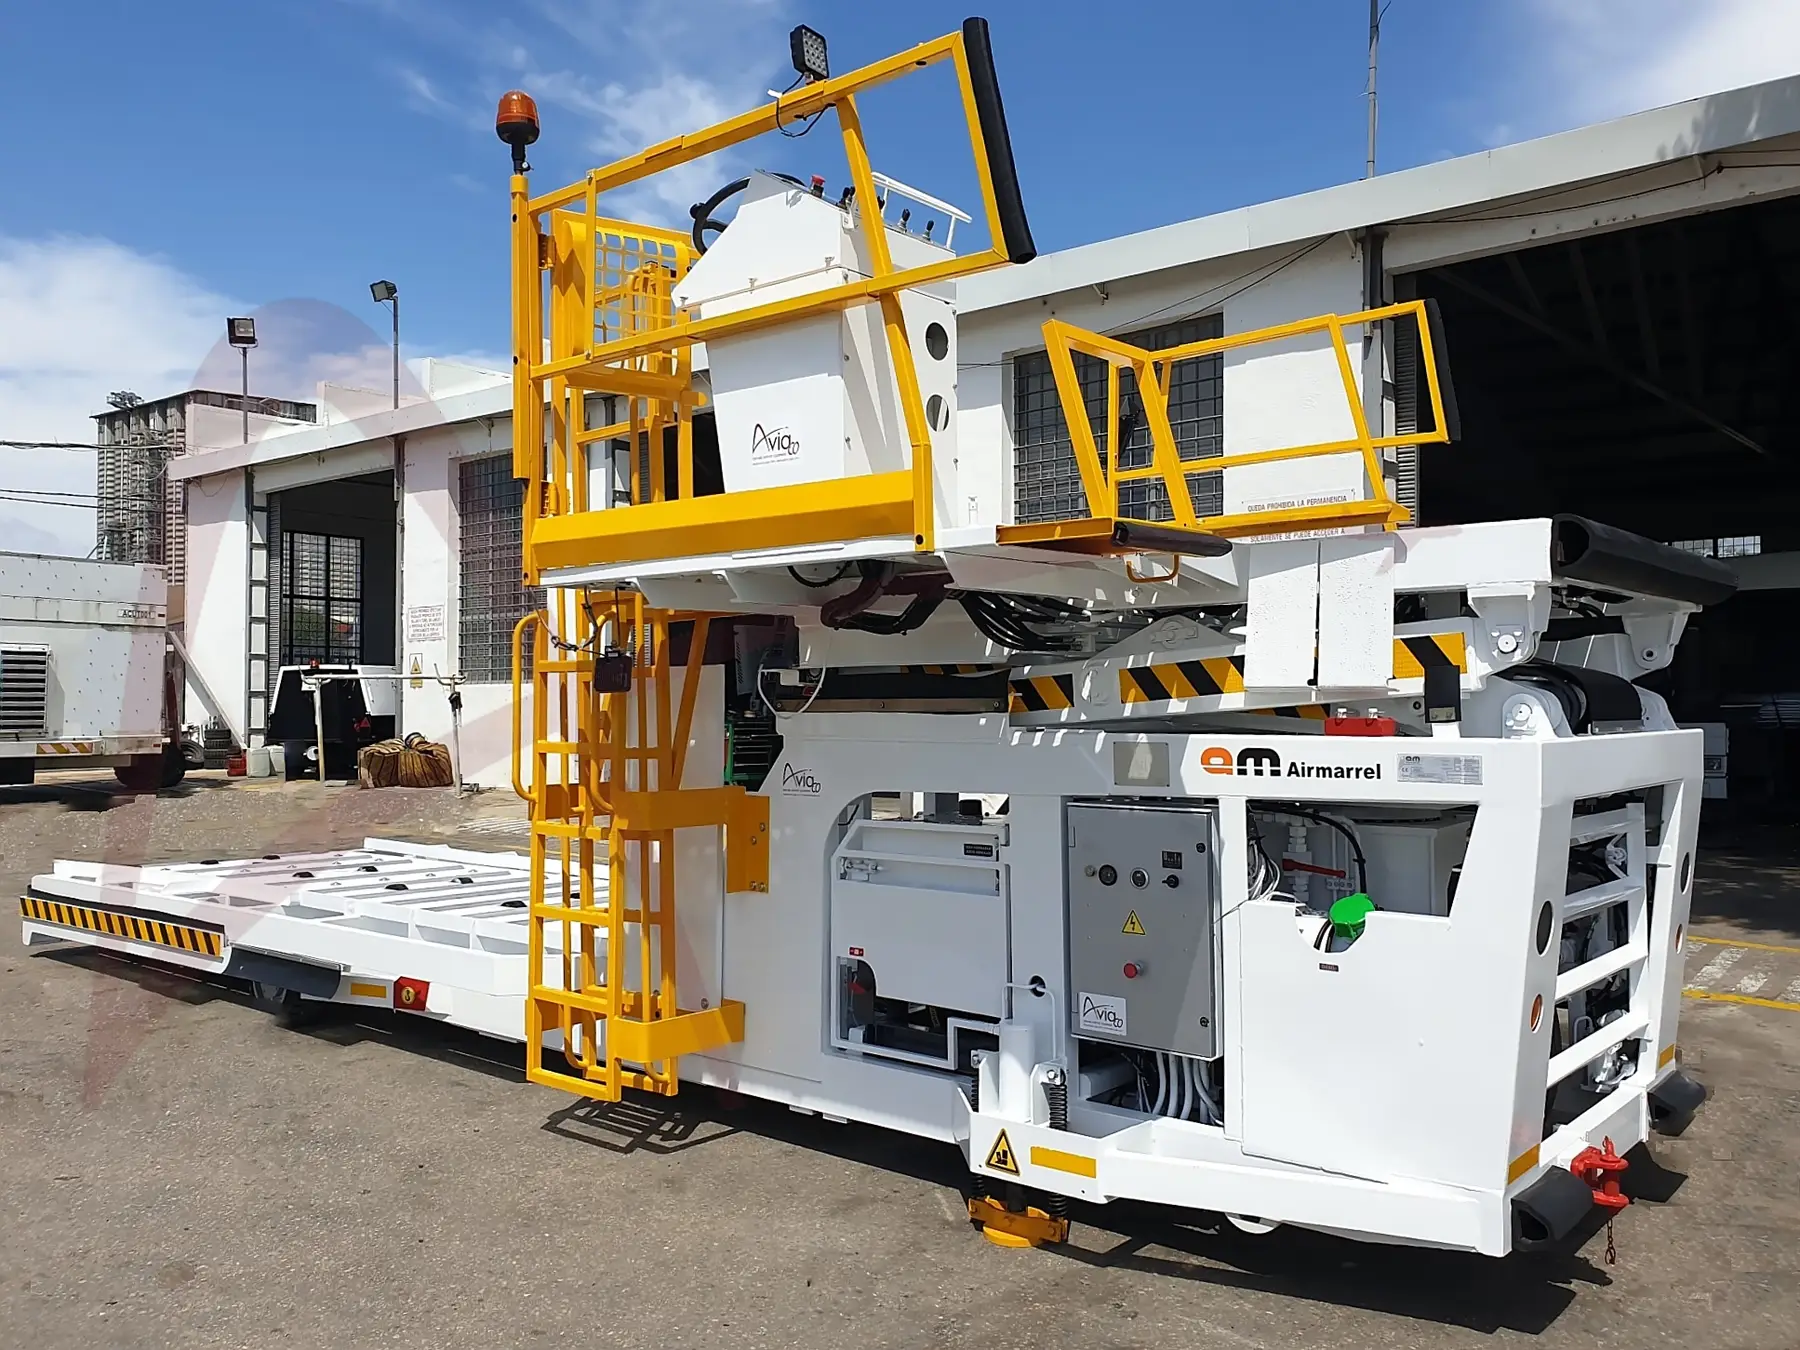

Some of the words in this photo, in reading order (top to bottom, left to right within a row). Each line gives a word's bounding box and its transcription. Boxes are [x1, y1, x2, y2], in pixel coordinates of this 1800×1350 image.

[1247, 504, 1266, 512] QUEDA
[1297, 499, 1305, 507] LA
[1306, 495, 1348, 506] PERMANENCIA
[1286, 761, 1382, 779] Airmarrel
